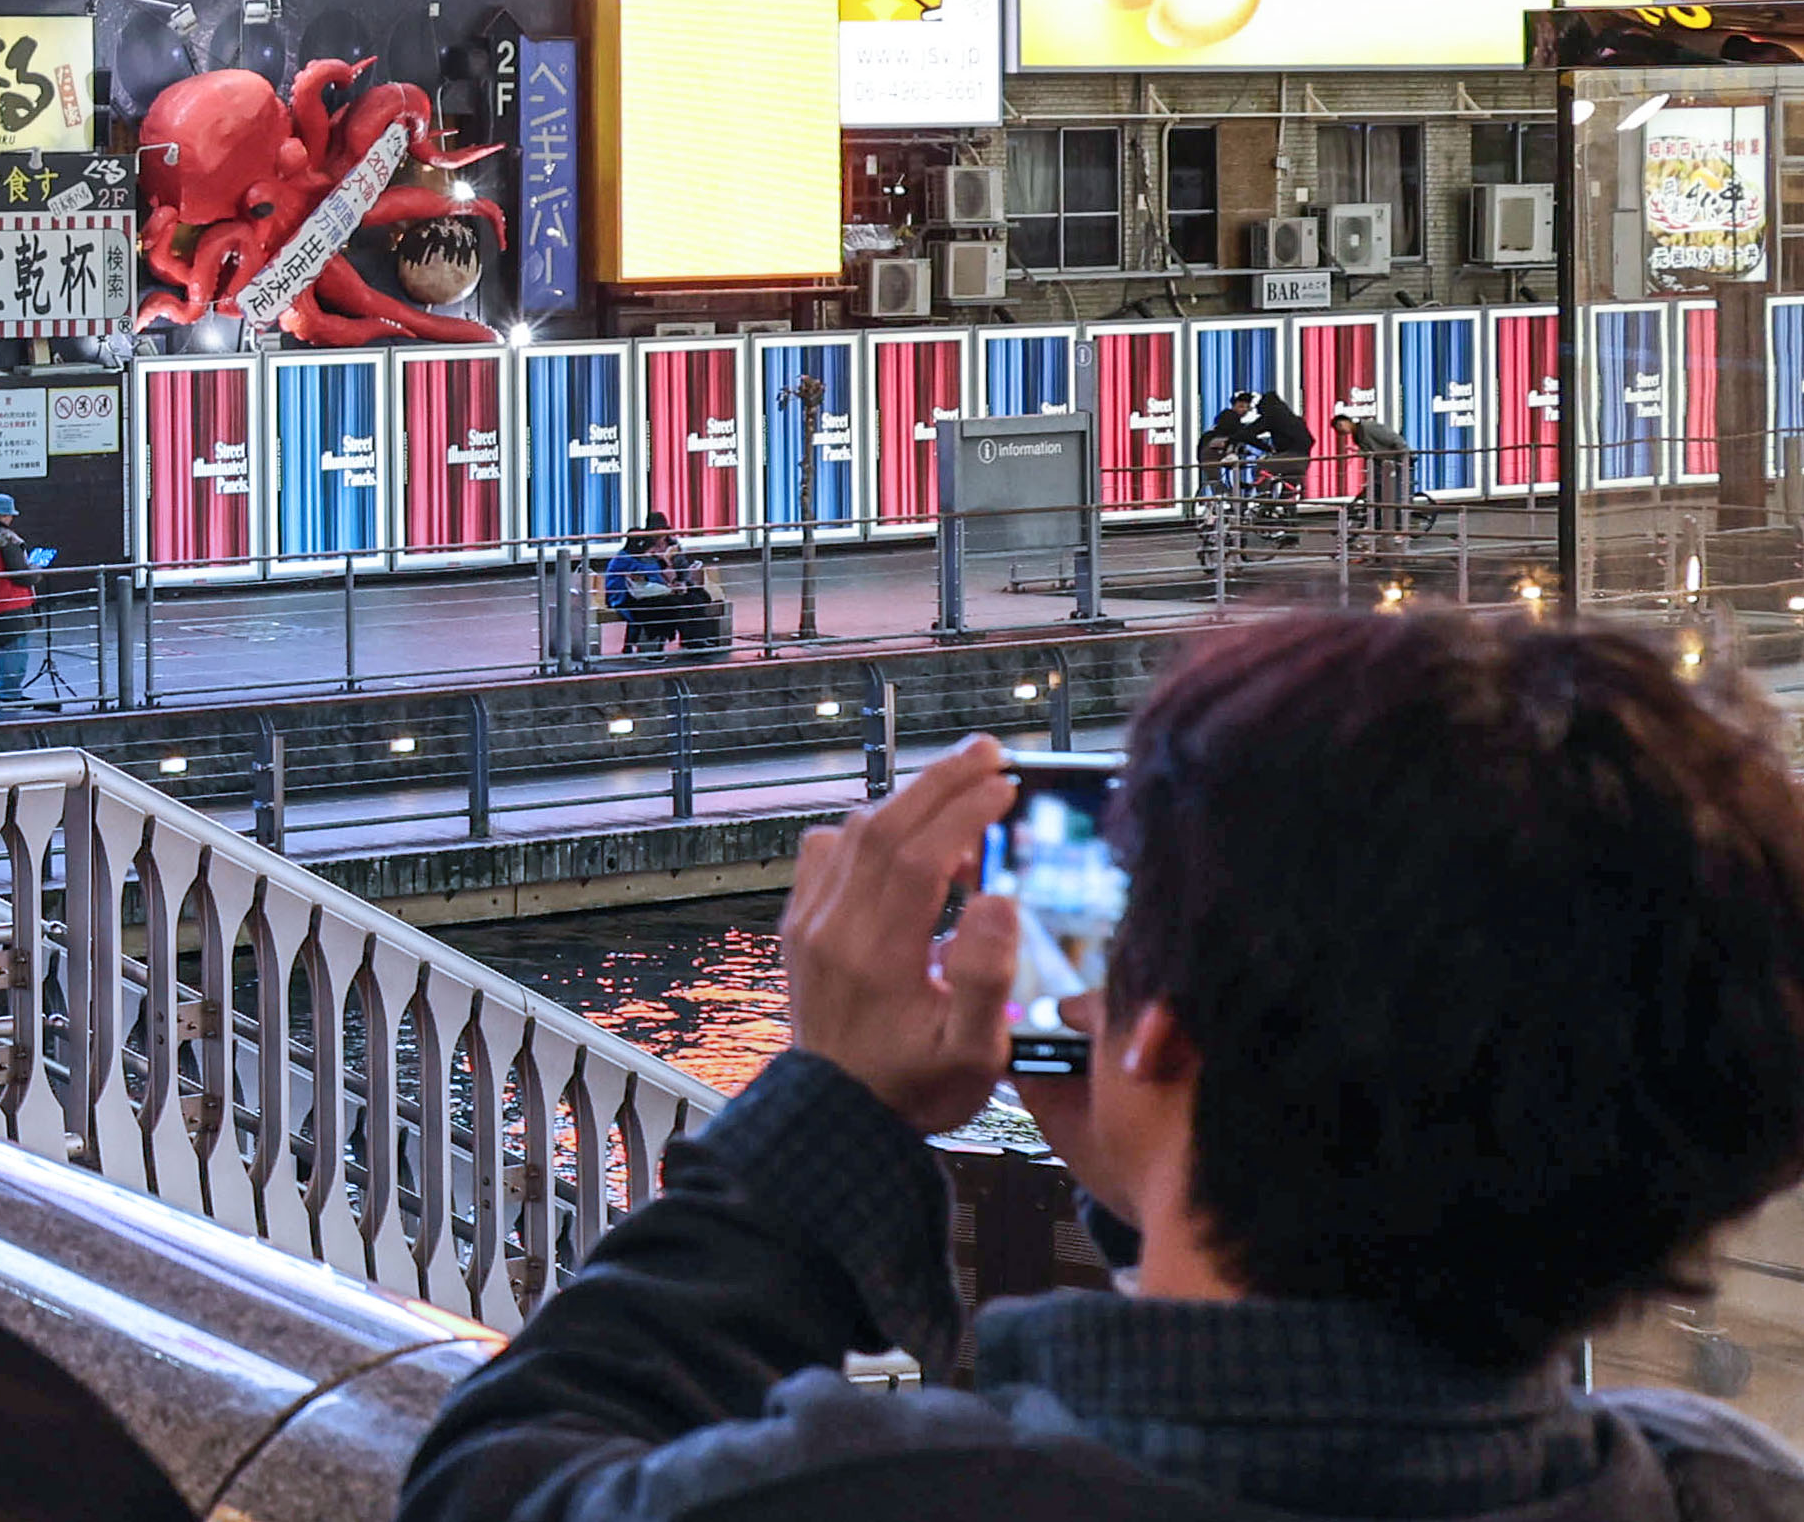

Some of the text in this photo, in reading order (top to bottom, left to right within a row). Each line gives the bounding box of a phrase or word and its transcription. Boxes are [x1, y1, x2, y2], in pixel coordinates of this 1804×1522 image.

[528, 60, 569, 285] ペンギンバー
[97, 187, 128, 210] 2F
[105, 244, 125, 300] 検索
[1267, 281, 1300, 302] BAR
[468, 429, 497, 447] Street
[589, 423, 618, 441] Street
[215, 441, 245, 459] Street
[342, 434, 373, 453] Street
[998, 440, 1062, 457] information
